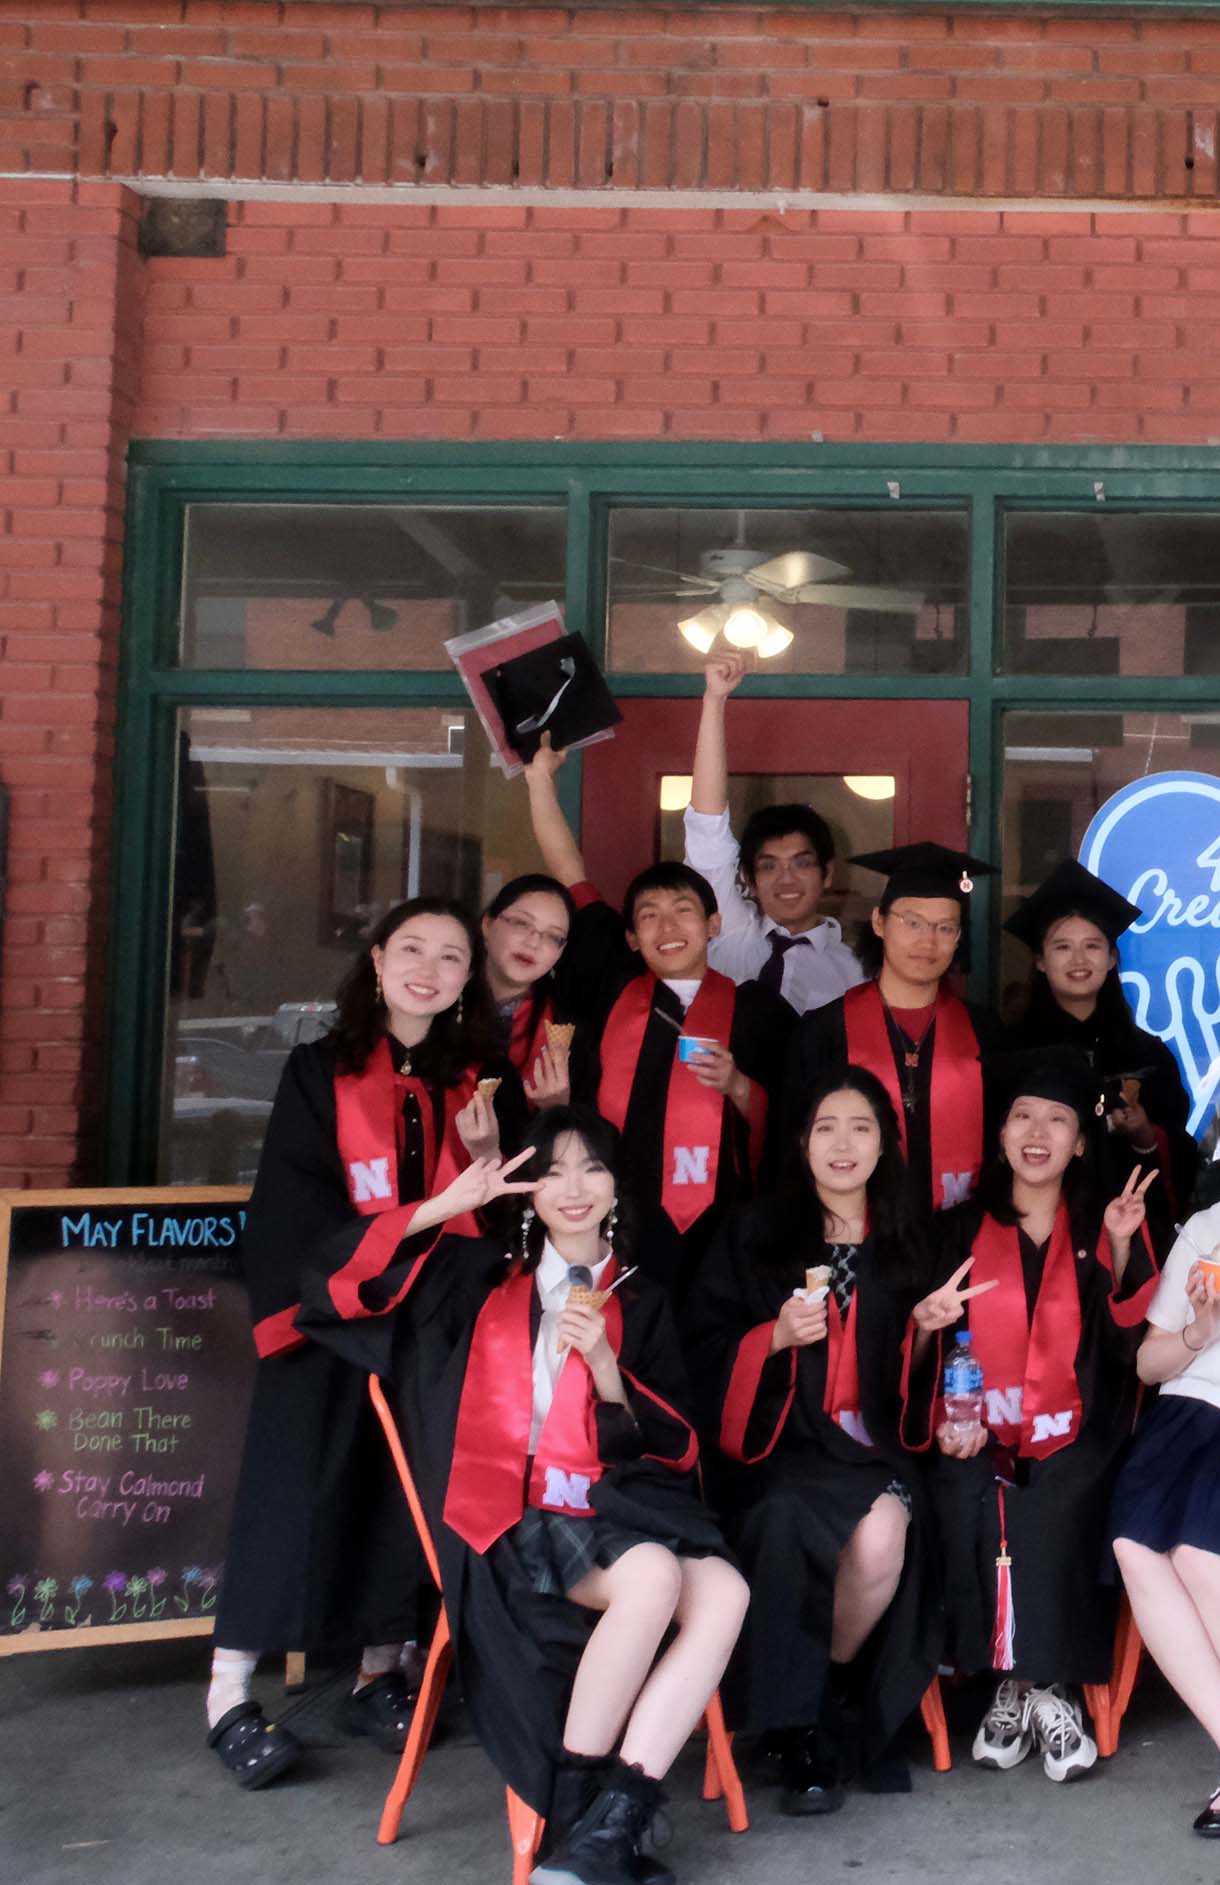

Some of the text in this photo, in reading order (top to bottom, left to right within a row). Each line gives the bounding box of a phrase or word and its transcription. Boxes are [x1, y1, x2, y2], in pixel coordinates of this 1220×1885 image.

[350, 1157, 392, 1201] N
[673, 1147, 709, 1184] N
[61, 1211, 123, 1247] MAY
[143, 1296, 157, 1311] a
[162, 1287, 216, 1311] Toast
[155, 1327, 203, 1350] Time
[68, 1367, 189, 1399] Poppy Love
[68, 1406, 192, 1431] Bean There
[985, 1386, 1023, 1425] N
[73, 1432, 180, 1453] Done That
[1030, 1410, 1073, 1443] N
[57, 1469, 205, 1499] Stay Calmond
[543, 1466, 591, 1510] N
[76, 1496, 171, 1527] Carry On
